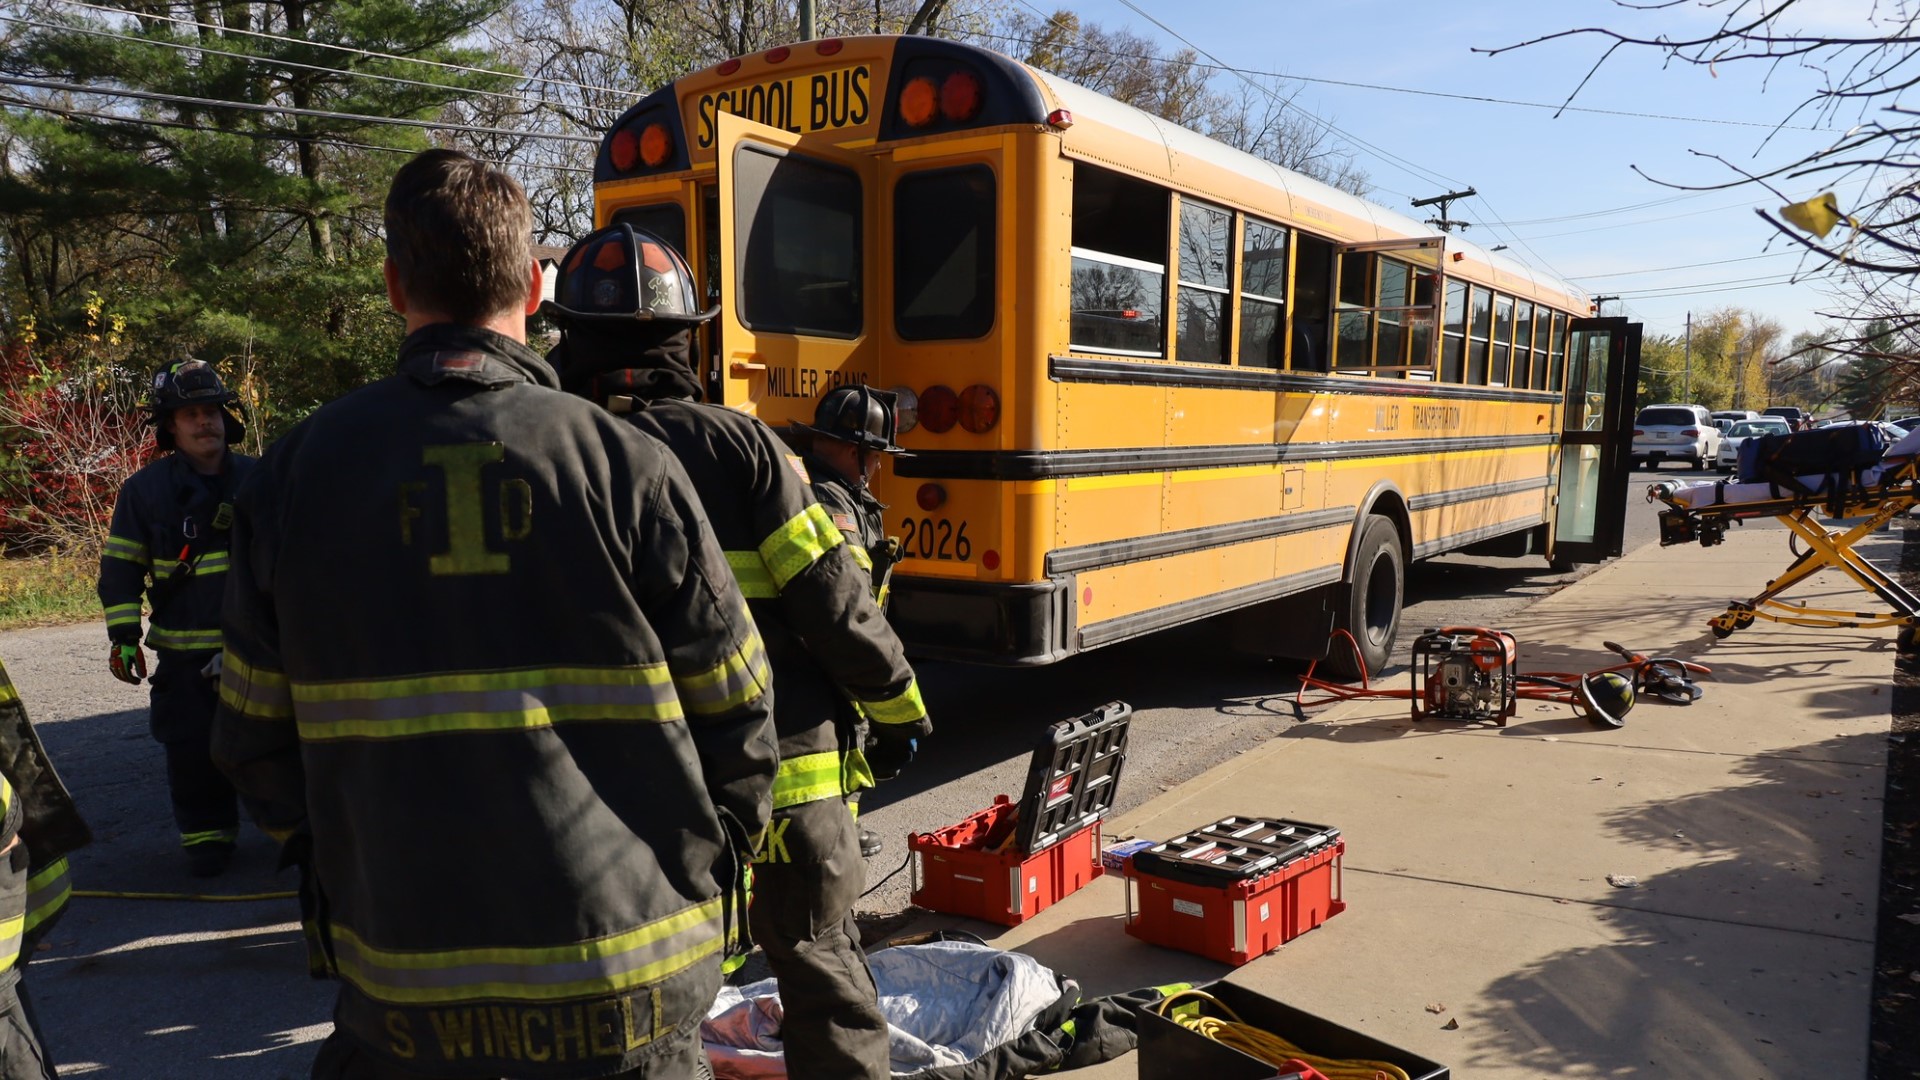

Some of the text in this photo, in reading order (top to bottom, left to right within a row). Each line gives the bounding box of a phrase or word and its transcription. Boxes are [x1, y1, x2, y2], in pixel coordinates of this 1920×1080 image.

[698, 66, 869, 149] SCHOOL BUS
[767, 366, 818, 398] MILLER
[422, 441, 511, 576] I
[901, 516, 971, 561] 2026
[385, 987, 678, 1062] S WINCHELL
